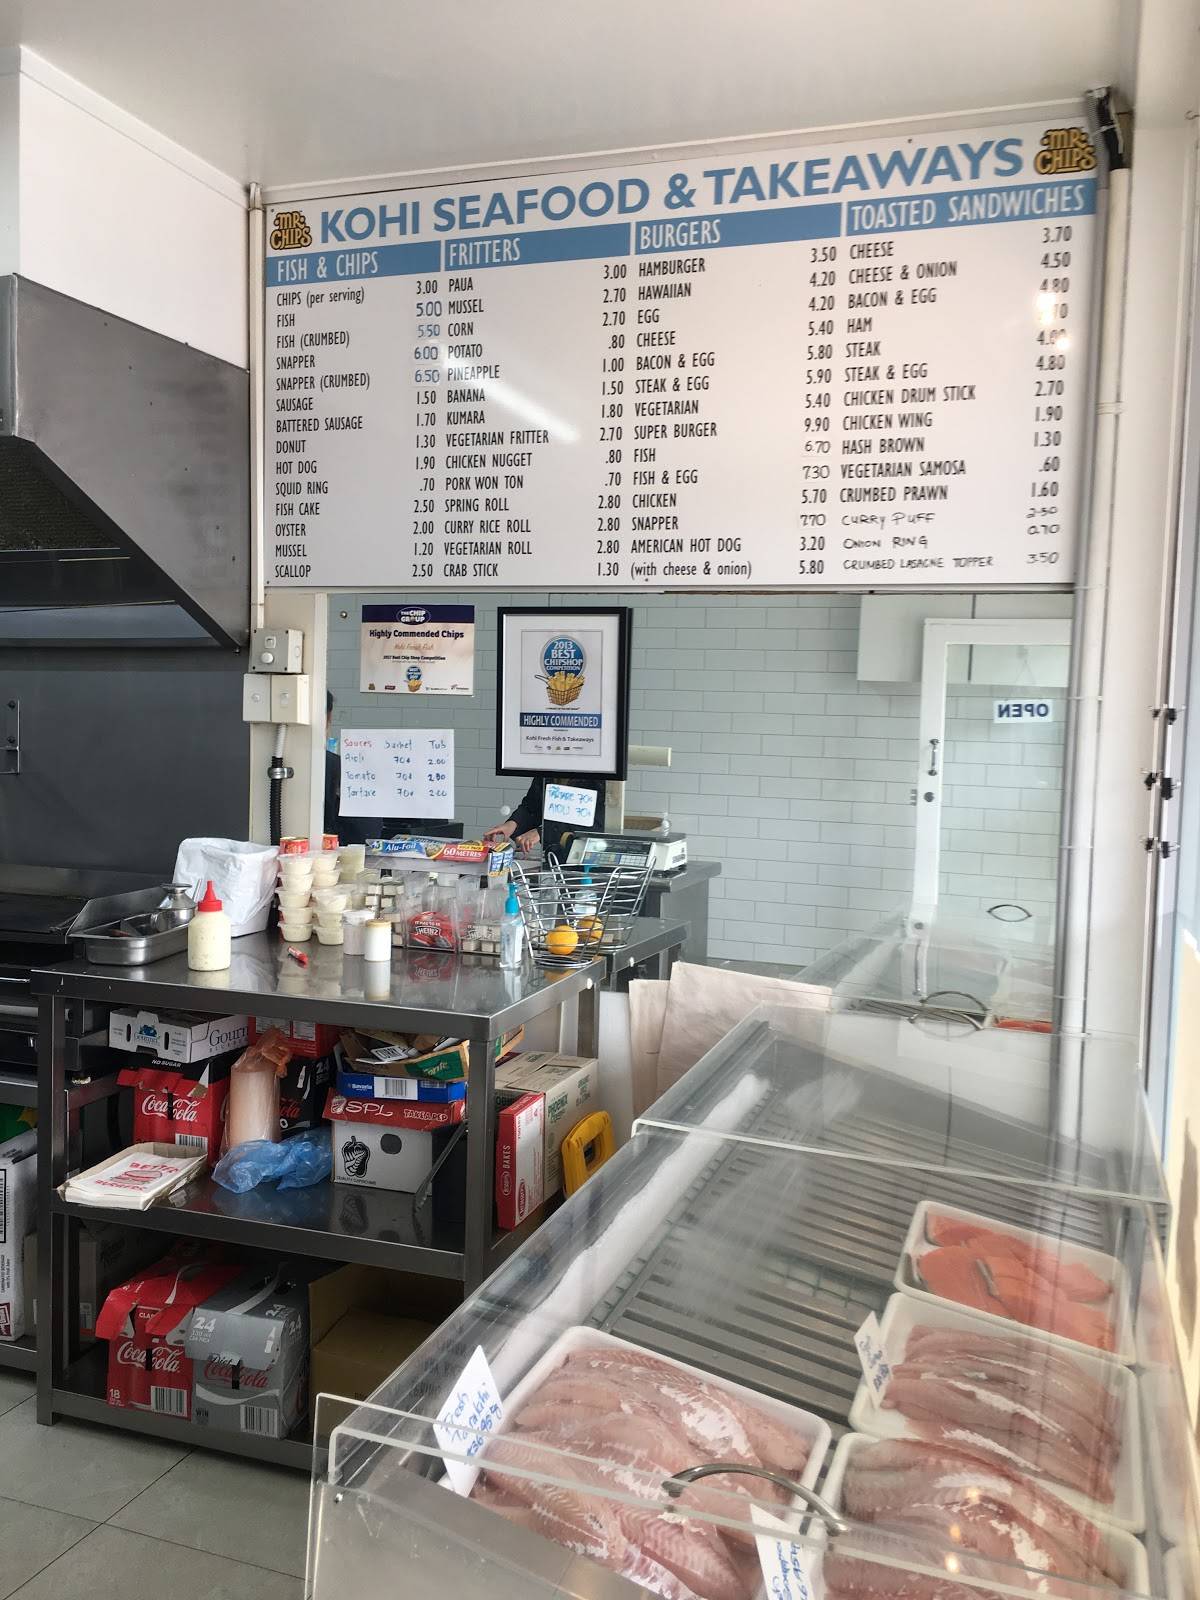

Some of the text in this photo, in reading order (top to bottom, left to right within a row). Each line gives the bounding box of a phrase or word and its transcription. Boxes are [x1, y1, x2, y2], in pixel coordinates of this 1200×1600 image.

[1033, 148, 1097, 175] CHIPS
[321, 138, 1023, 244] KOHI SEAFOOD & TAKEAWAYS
[851, 185, 1084, 231] TOASTED SANDWICHES
[270, 226, 312, 250] CHIPS
[640, 219, 720, 249] BURGERS
[449, 238, 521, 267] FRITTERS
[849, 241, 894, 260] CHEESE
[277, 252, 378, 282] FISH & CHIPS
[638, 257, 706, 277] HAMBURGER
[848, 261, 958, 284] CHEESE & ONION
[448, 277, 474, 293] PAUA
[638, 282, 692, 301] HAWAIIAN
[276, 286, 365, 308] CHIPS (per serving)
[848, 287, 937, 309] BACON & EGG
[448, 298, 484, 315] MUSSEL
[277, 313, 295, 328] FISH
[637, 308, 660, 324] EGG
[448, 321, 474, 337] CORN
[847, 317, 873, 334] HAM
[276, 330, 350, 351] FISH (CRUMBED)
[636, 330, 676, 348] CHEESE
[448, 343, 483, 359] POTATO
[845, 341, 881, 358] STEAK
[276, 354, 316, 370] SNAPPER
[636, 351, 715, 371] BACON & EGG
[447, 364, 500, 381] PINEAPPLE
[844, 362, 928, 383] STEAK & EGG
[276, 372, 370, 393] SNAPPER (CRUMBED)
[635, 375, 710, 394] STEAK & EGG
[276, 397, 314, 412] SAUSAGE
[447, 388, 486, 404] BANANA
[843, 385, 976, 407] CHICKEN DRUM STICK
[634, 399, 699, 417] VEGETARIAN
[276, 415, 363, 433] BATTERED SAUSAGE
[446, 410, 485, 426] KUMARA
[842, 411, 933, 431] CHICKEN WING
[445, 429, 549, 447] VEGETARIAN FRITTER
[634, 422, 718, 440] SUPER BURGER
[276, 439, 307, 454] DONUT
[842, 437, 925, 455] HASH BROWN
[445, 452, 533, 469] CHICKEN NUGGET
[634, 448, 656, 463] FISH
[276, 460, 317, 475] HOT DOG
[840, 460, 966, 479] VEGETARIAN SAMOSA
[445, 475, 524, 491] PORK WON TON
[633, 469, 698, 486] FISH & EGG
[275, 480, 328, 498] SQUID RING
[839, 485, 948, 503] CRUMBED PRAWN
[275, 502, 320, 516] FISH CAKE
[445, 497, 510, 513] SPRING ROLL
[632, 493, 677, 508] CHICKEN
[275, 523, 306, 537] OYSTER
[444, 519, 532, 534] CURRY RICE ROLL
[631, 516, 679, 531] SNAPPER
[275, 544, 308, 558] MUSSEL
[444, 541, 533, 556] VEGETARIAN ROLL
[630, 537, 742, 554] AMERICAN HOT DOG
[275, 564, 311, 578] SCALLOP
[443, 563, 499, 577] CRAB STICK
[630, 560, 752, 579] (with cheese & onion)
[369, 630, 464, 640] Highly Commended Chips
[551, 649, 576, 659] BEST
[553, 641, 573, 650] 2013
[544, 658, 584, 666] CHIPSHOP
[523, 715, 599, 727] HIGHLY COMMENDED
[385, 842, 417, 851] Alu-Foil
[444, 847, 456, 856] 60
[417, 928, 439, 936] HEINZ
[161, 1060, 182, 1068] SUGAR
[345, 1100, 394, 1117] SPL
[502, 1144, 511, 1169] BAKES
[194, 1316, 215, 1332] 24
[109, 1388, 120, 1399] 18
